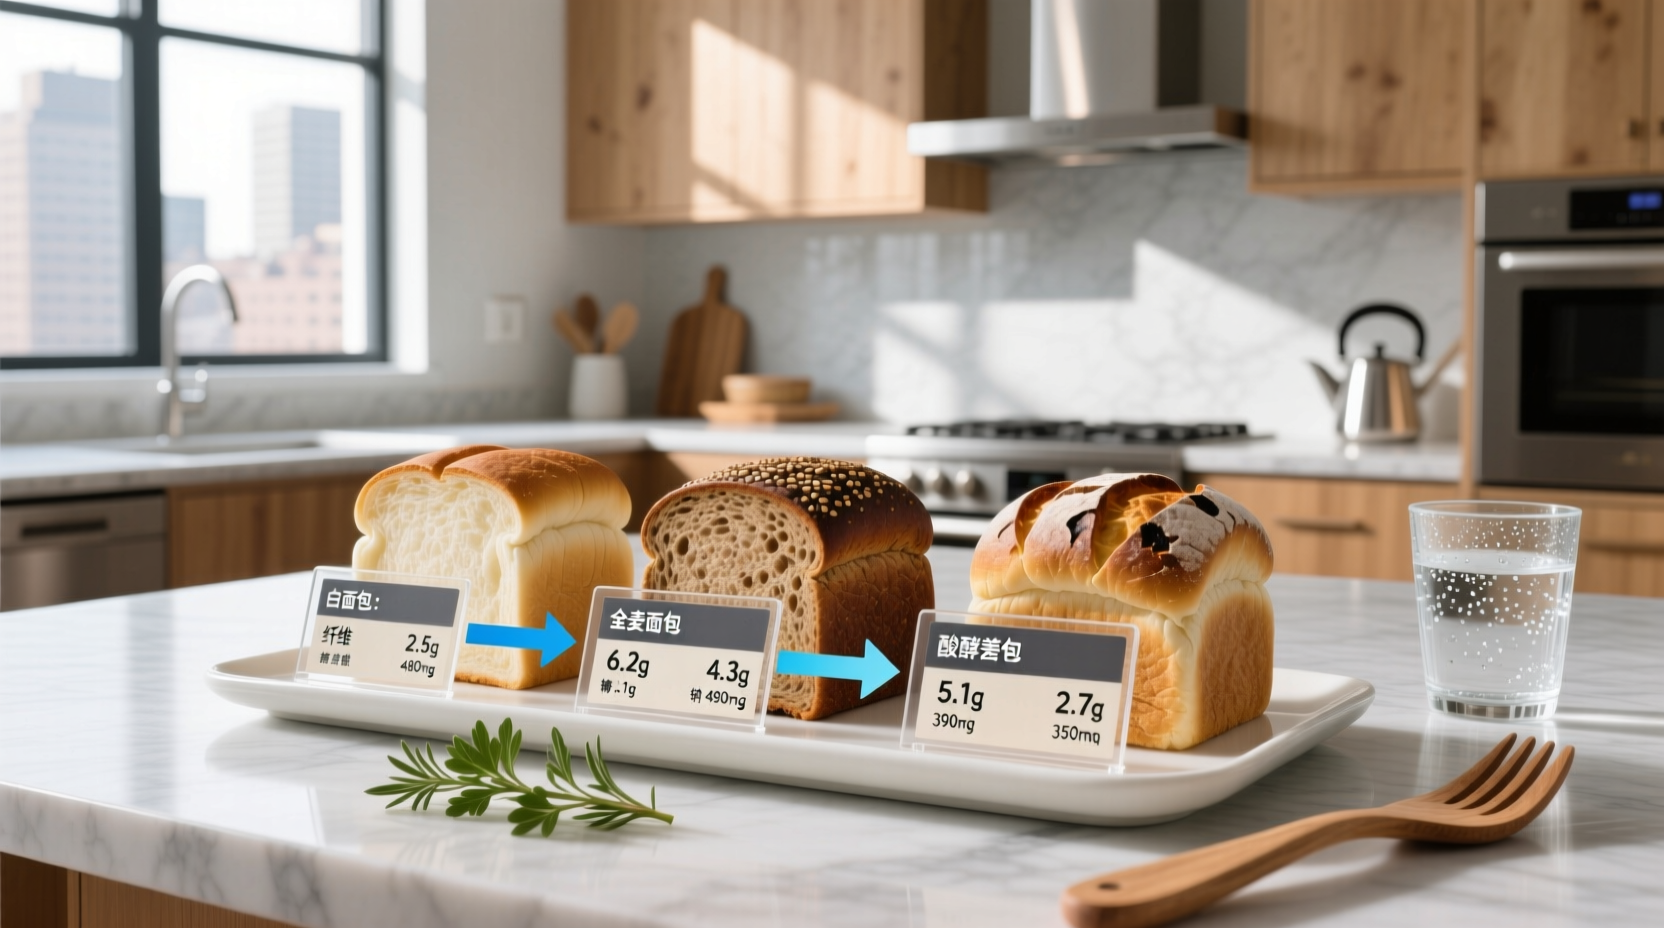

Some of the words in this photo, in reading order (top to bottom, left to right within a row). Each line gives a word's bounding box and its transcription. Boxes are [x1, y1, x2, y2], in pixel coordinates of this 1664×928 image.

[326, 588, 380, 611] 白面包:
[610, 608, 681, 635] 全麦面包
[321, 625, 353, 646] 纤维
[405, 634, 439, 658] 2.5g
[606, 649, 650, 678] 6.2g
[706, 659, 750, 688] 4.3g
[937, 680, 984, 712] 5.1g
[1055, 690, 1105, 723] 2.7g
